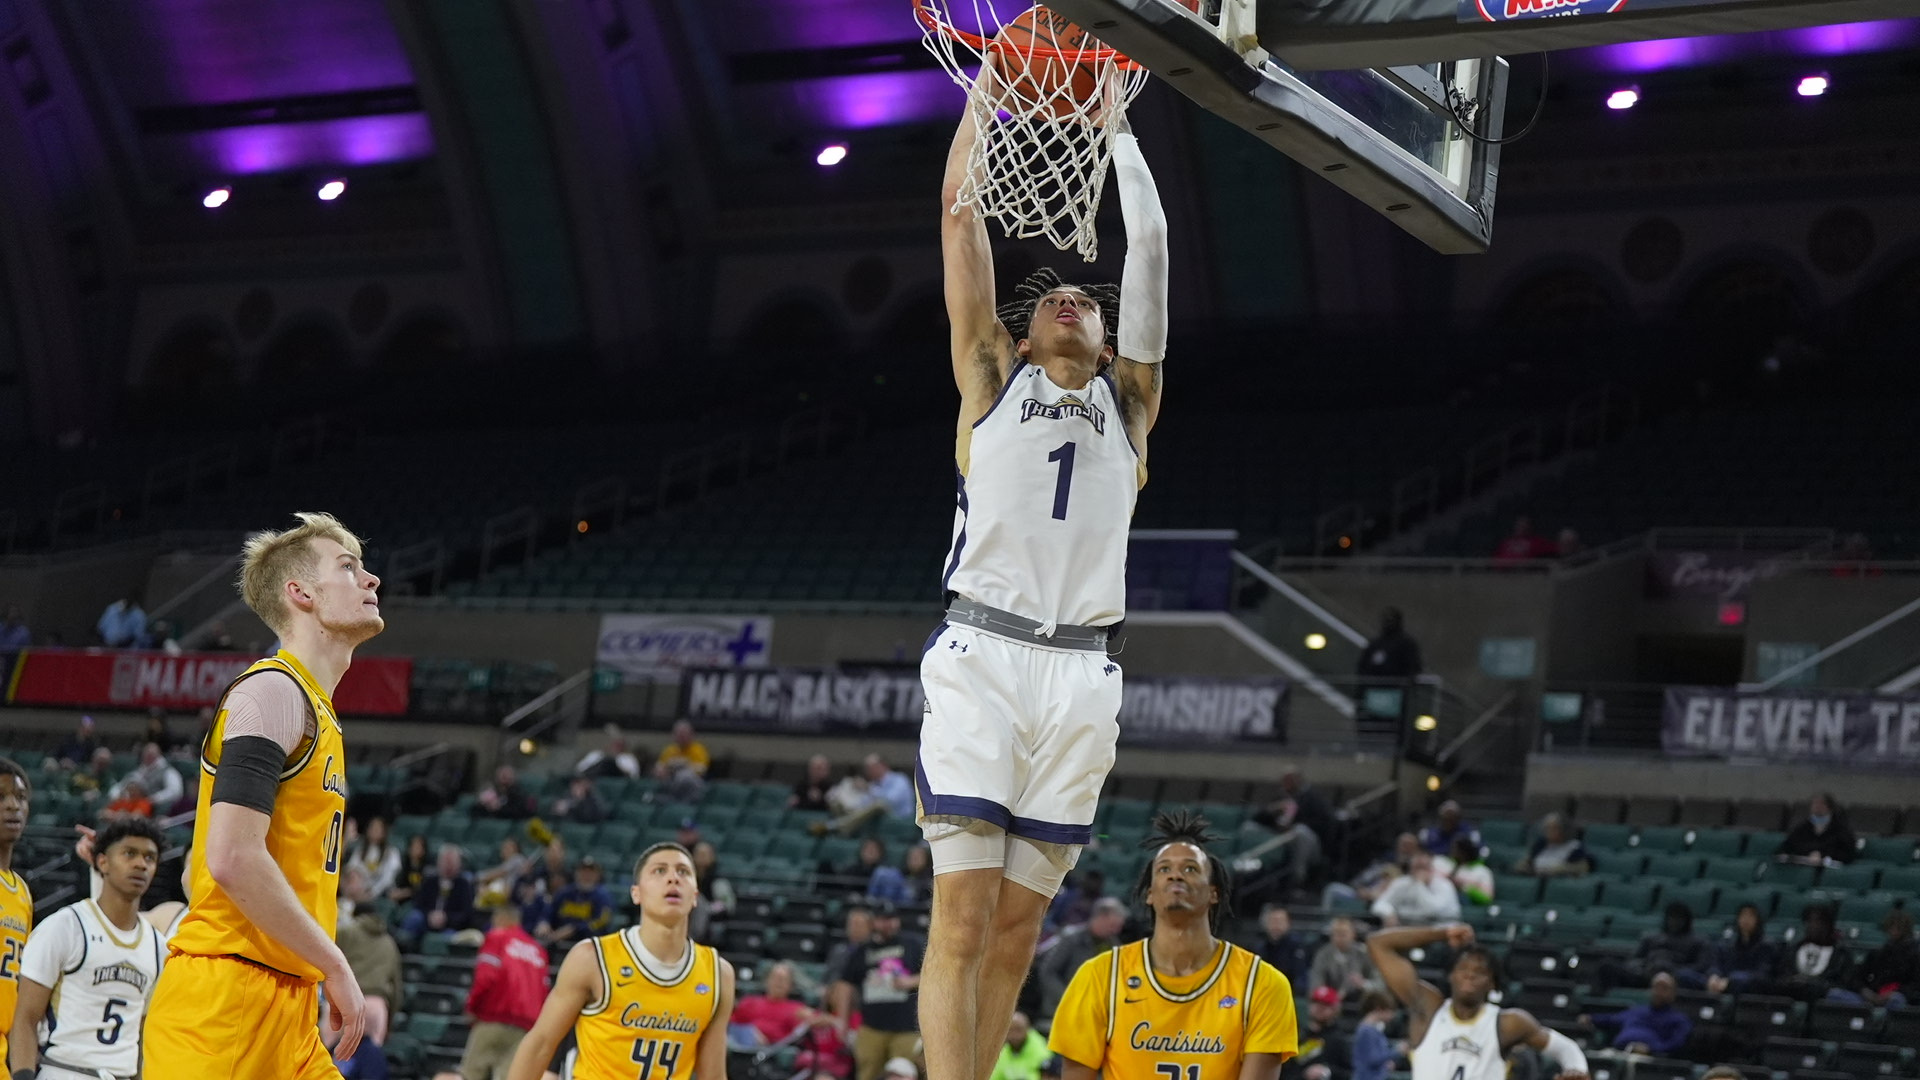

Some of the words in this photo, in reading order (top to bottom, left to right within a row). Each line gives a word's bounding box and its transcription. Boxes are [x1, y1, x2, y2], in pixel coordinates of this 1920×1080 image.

[1021, 399, 1057, 423] THE
[1047, 441, 1077, 521] 1
[689, 672, 780, 716] MAAC
[1683, 697, 1847, 754] ELEVEN
[93, 967, 117, 986] THE
[117, 968, 148, 994] MOUNT
[96, 998, 128, 1045] 5
[620, 1001, 699, 1034] Canisius
[1130, 1020, 1226, 1054] Canisius
[630, 1037, 682, 1080] 44
